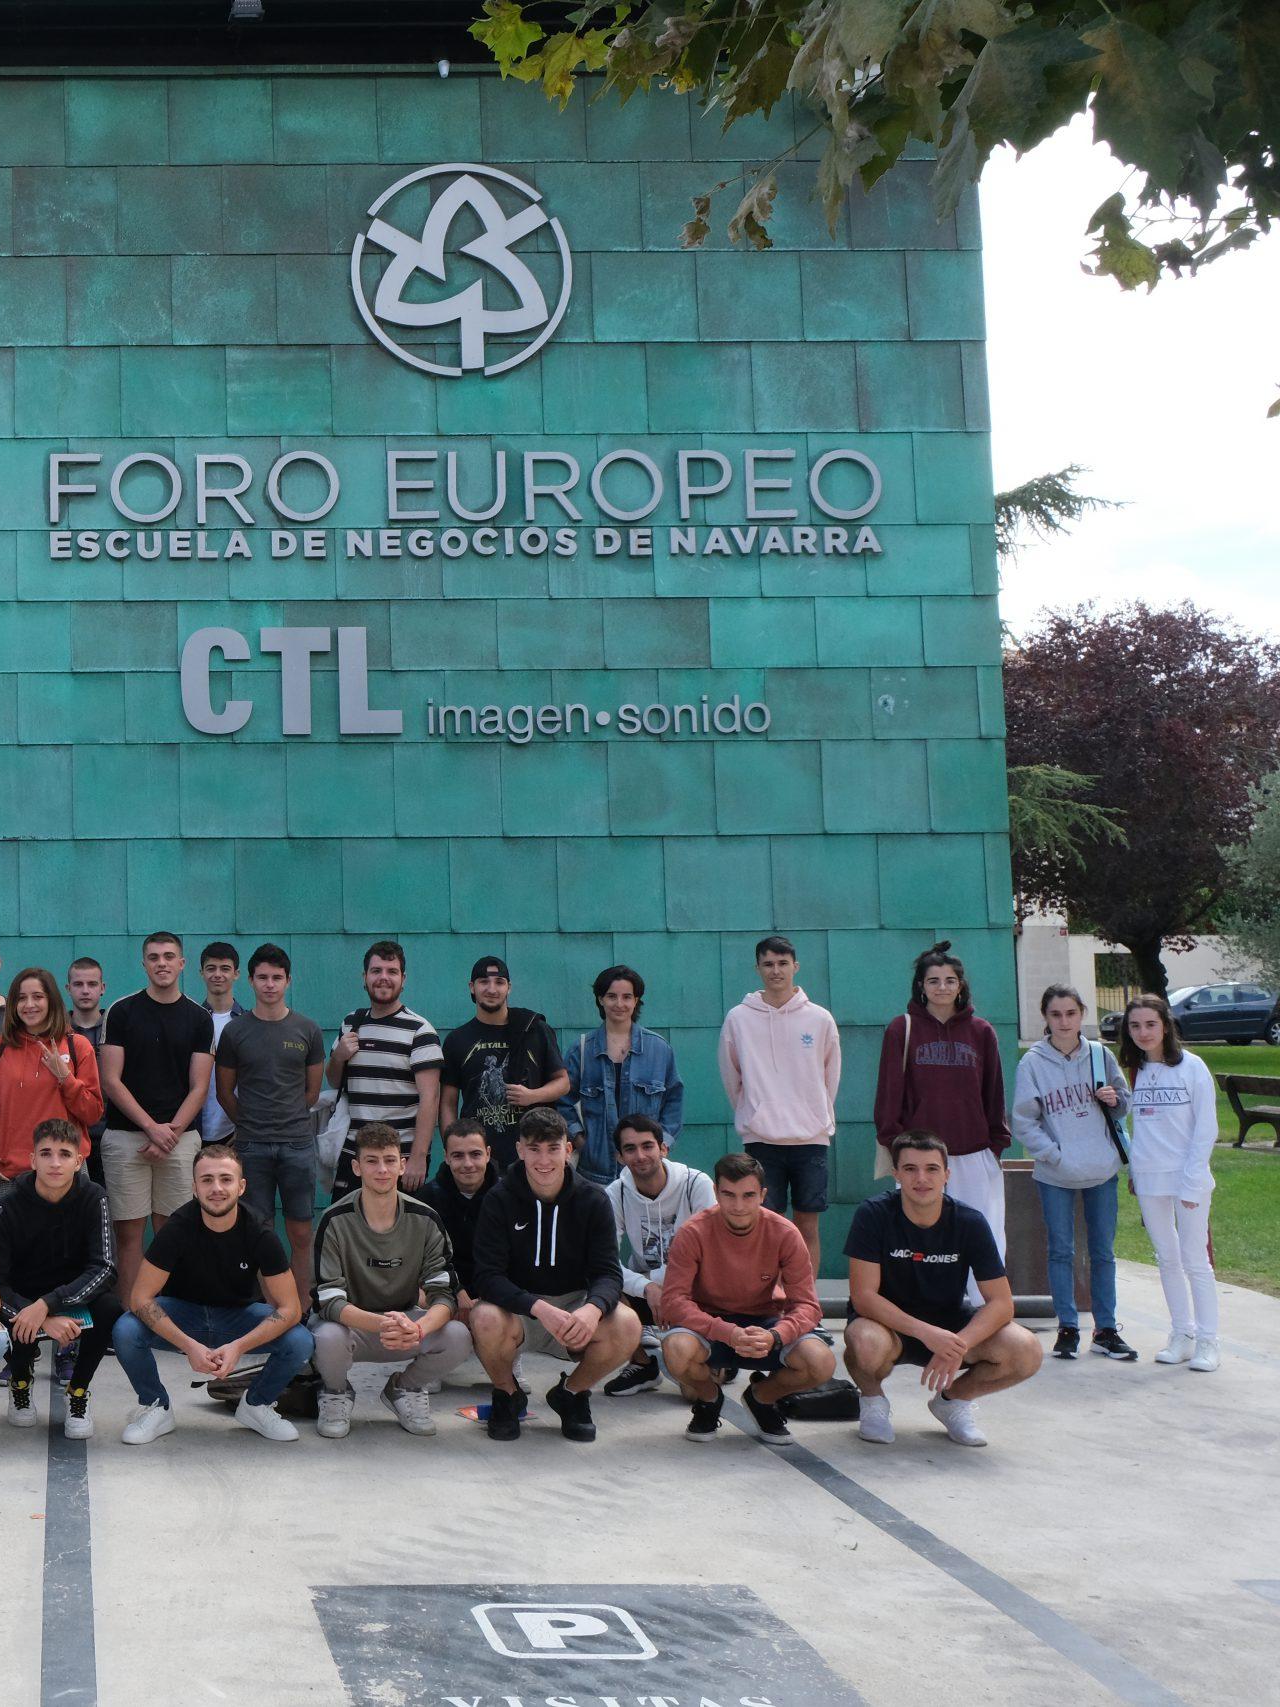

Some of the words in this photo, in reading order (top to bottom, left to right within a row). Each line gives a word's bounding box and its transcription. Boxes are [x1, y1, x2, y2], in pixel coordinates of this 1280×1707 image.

[49, 450, 340, 524] FORO
[387, 449, 883, 521] EUROPEO
[49, 530, 252, 559] ESCUELA
[271, 529, 327, 558] DE
[346, 527, 578, 557] NEGOCIOS
[595, 528, 652, 556] DE
[670, 526, 883, 555] NAVARRA
[180, 626, 403, 735] CTL
[1044, 1082, 1095, 1115] HARVA
[512, 1611, 609, 1648] P
